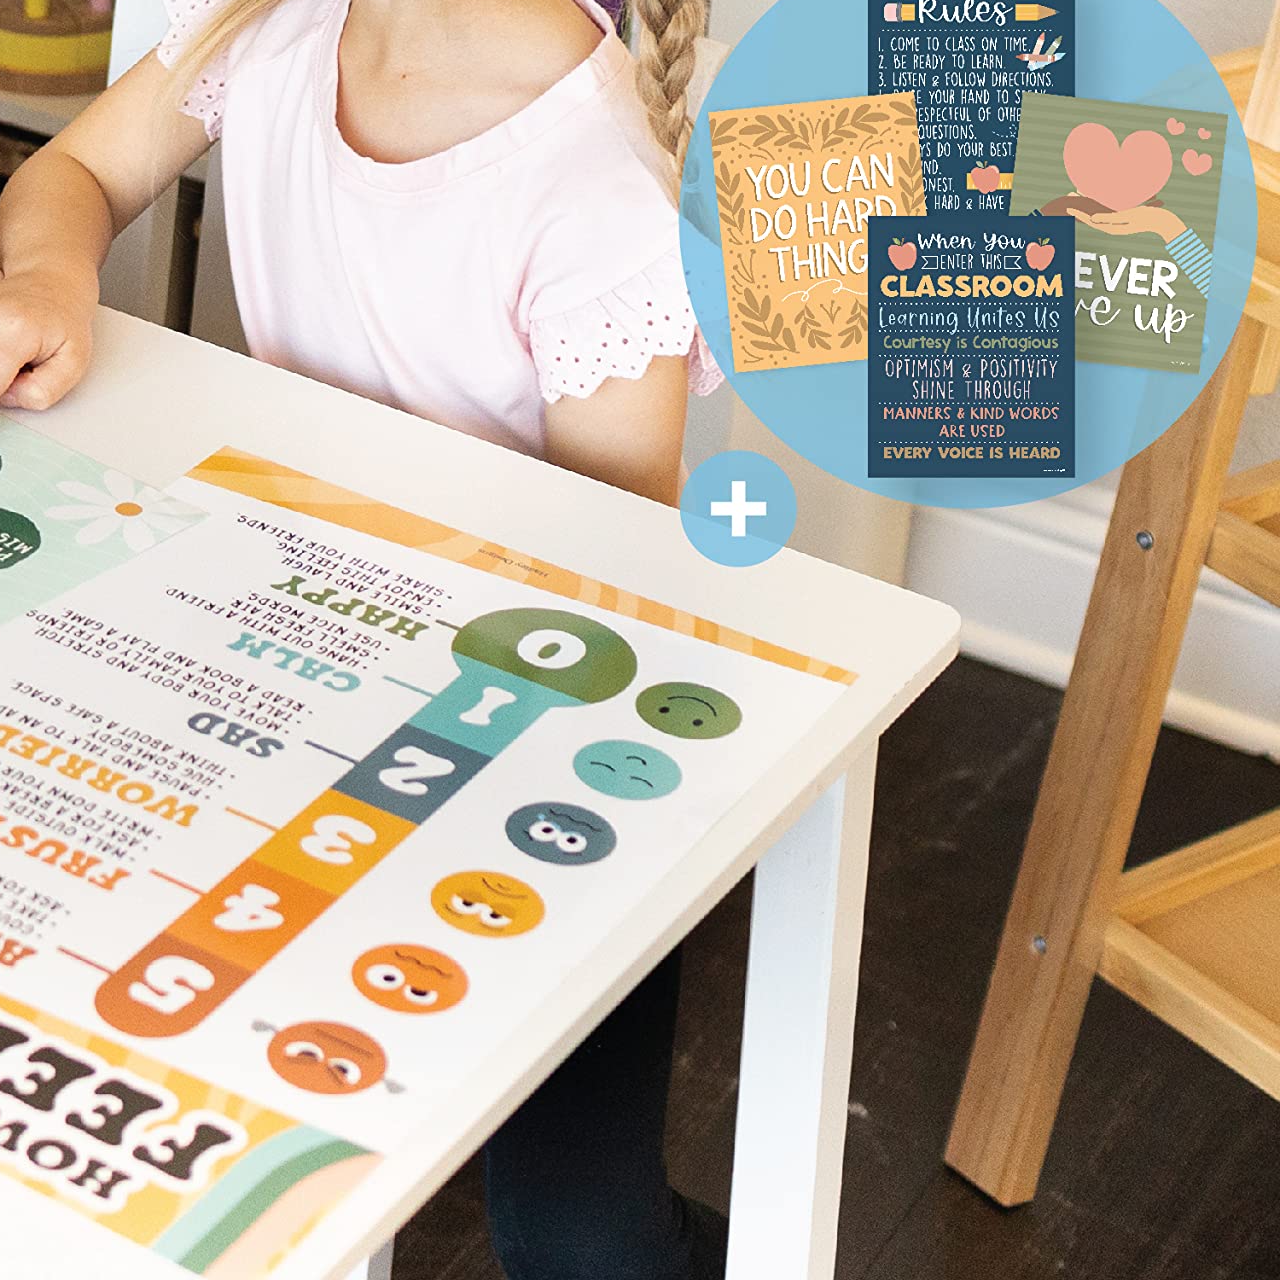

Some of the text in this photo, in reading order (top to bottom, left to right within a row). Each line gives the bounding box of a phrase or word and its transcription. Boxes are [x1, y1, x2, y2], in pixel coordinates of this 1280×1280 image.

[235, 514, 444, 598] SHARE WITH YOUR FRIENDS.
[275, 541, 435, 607] ENJOY THIS FEELING.
[280, 556, 424, 616] SMILE AND LAUGH.
[164, 587, 361, 669] HANG OUT WITH FRIEND.
[229, 598, 371, 658] SMELL FRESH AIR.
[246, 591, 383, 650] USE NICE WORDS.
[269, 574, 431, 643] HAPPY
[225, 630, 362, 694] CALM
[515, 627, 588, 671] 0
[185, 711, 286, 759] SAD
[457, 685, 519, 728] 1
[377, 744, 457, 797] 2
[298, 813, 378, 867] 3
[211, 882, 286, 934] 4
[127, 954, 216, 1016] 5
